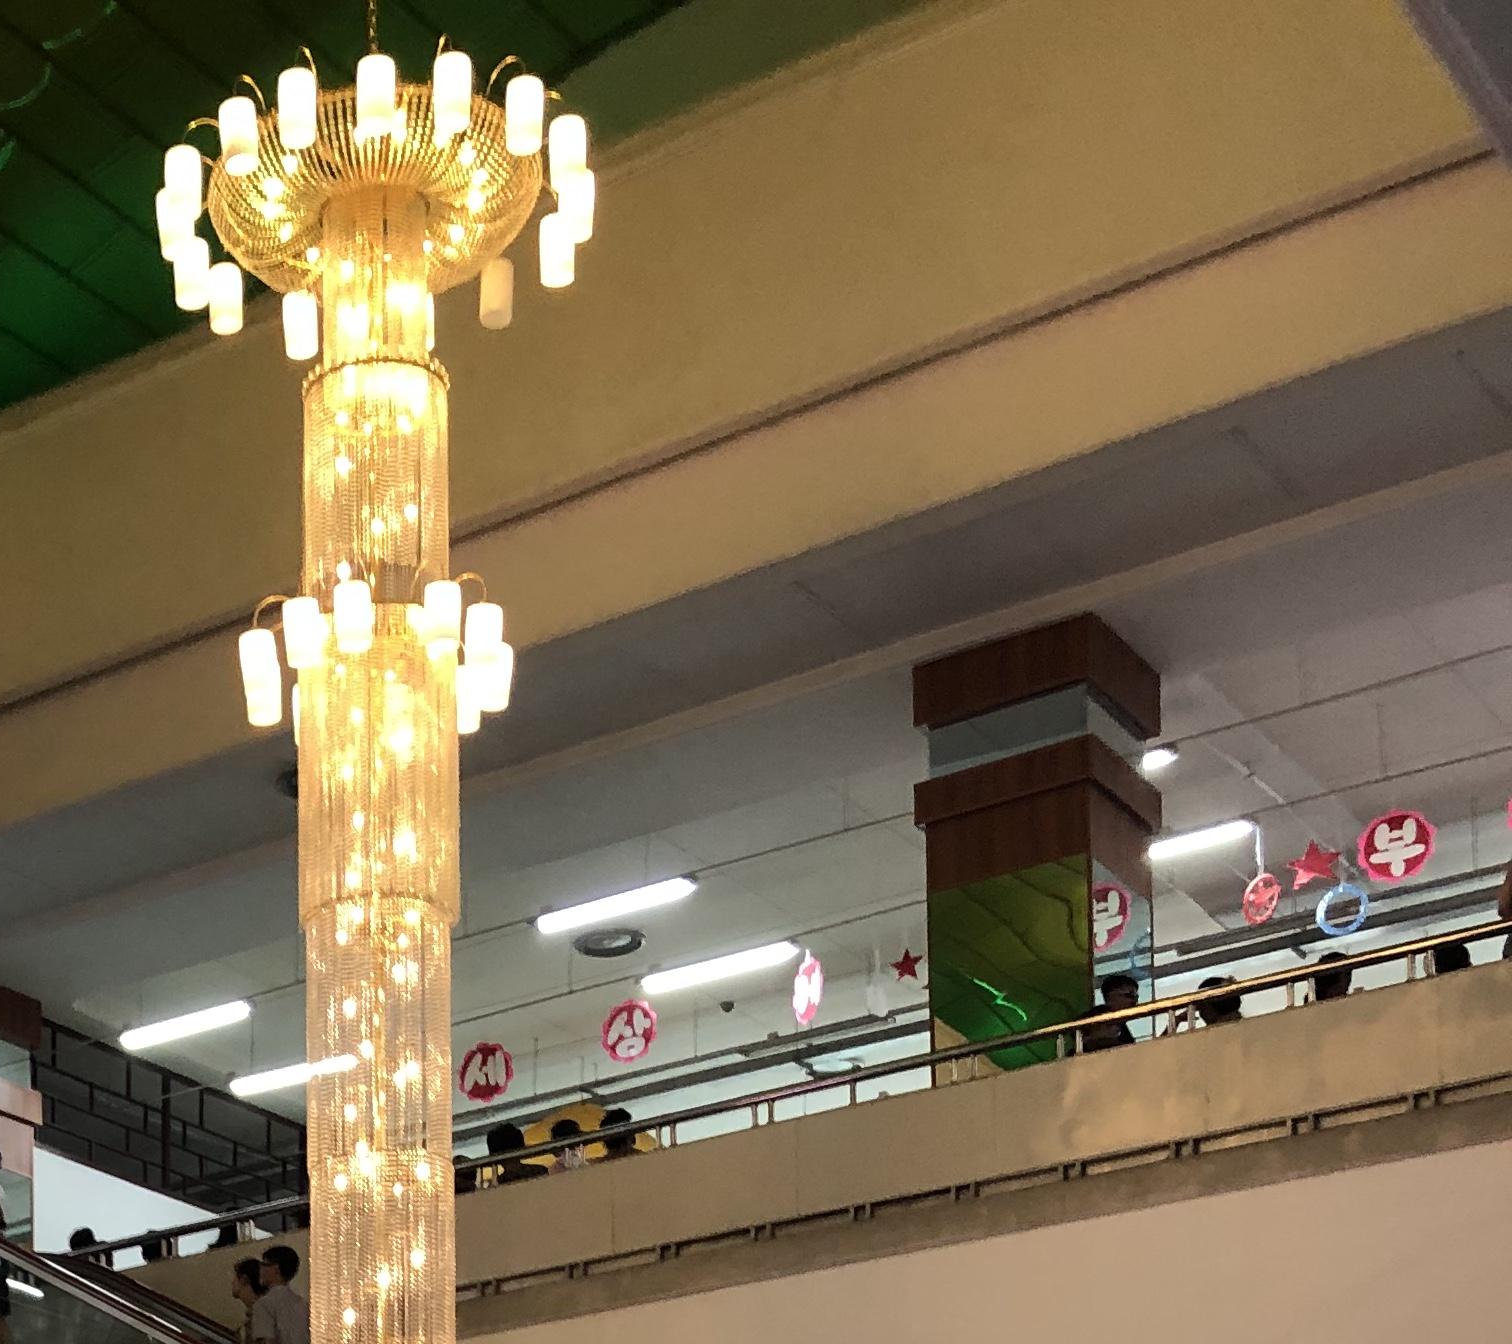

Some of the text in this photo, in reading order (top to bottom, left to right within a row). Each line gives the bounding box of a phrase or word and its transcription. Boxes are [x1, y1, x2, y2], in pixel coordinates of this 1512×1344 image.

[464, 1050, 504, 1093] 세
[608, 1007, 651, 1057] 상
[1370, 817, 1425, 877] 부
